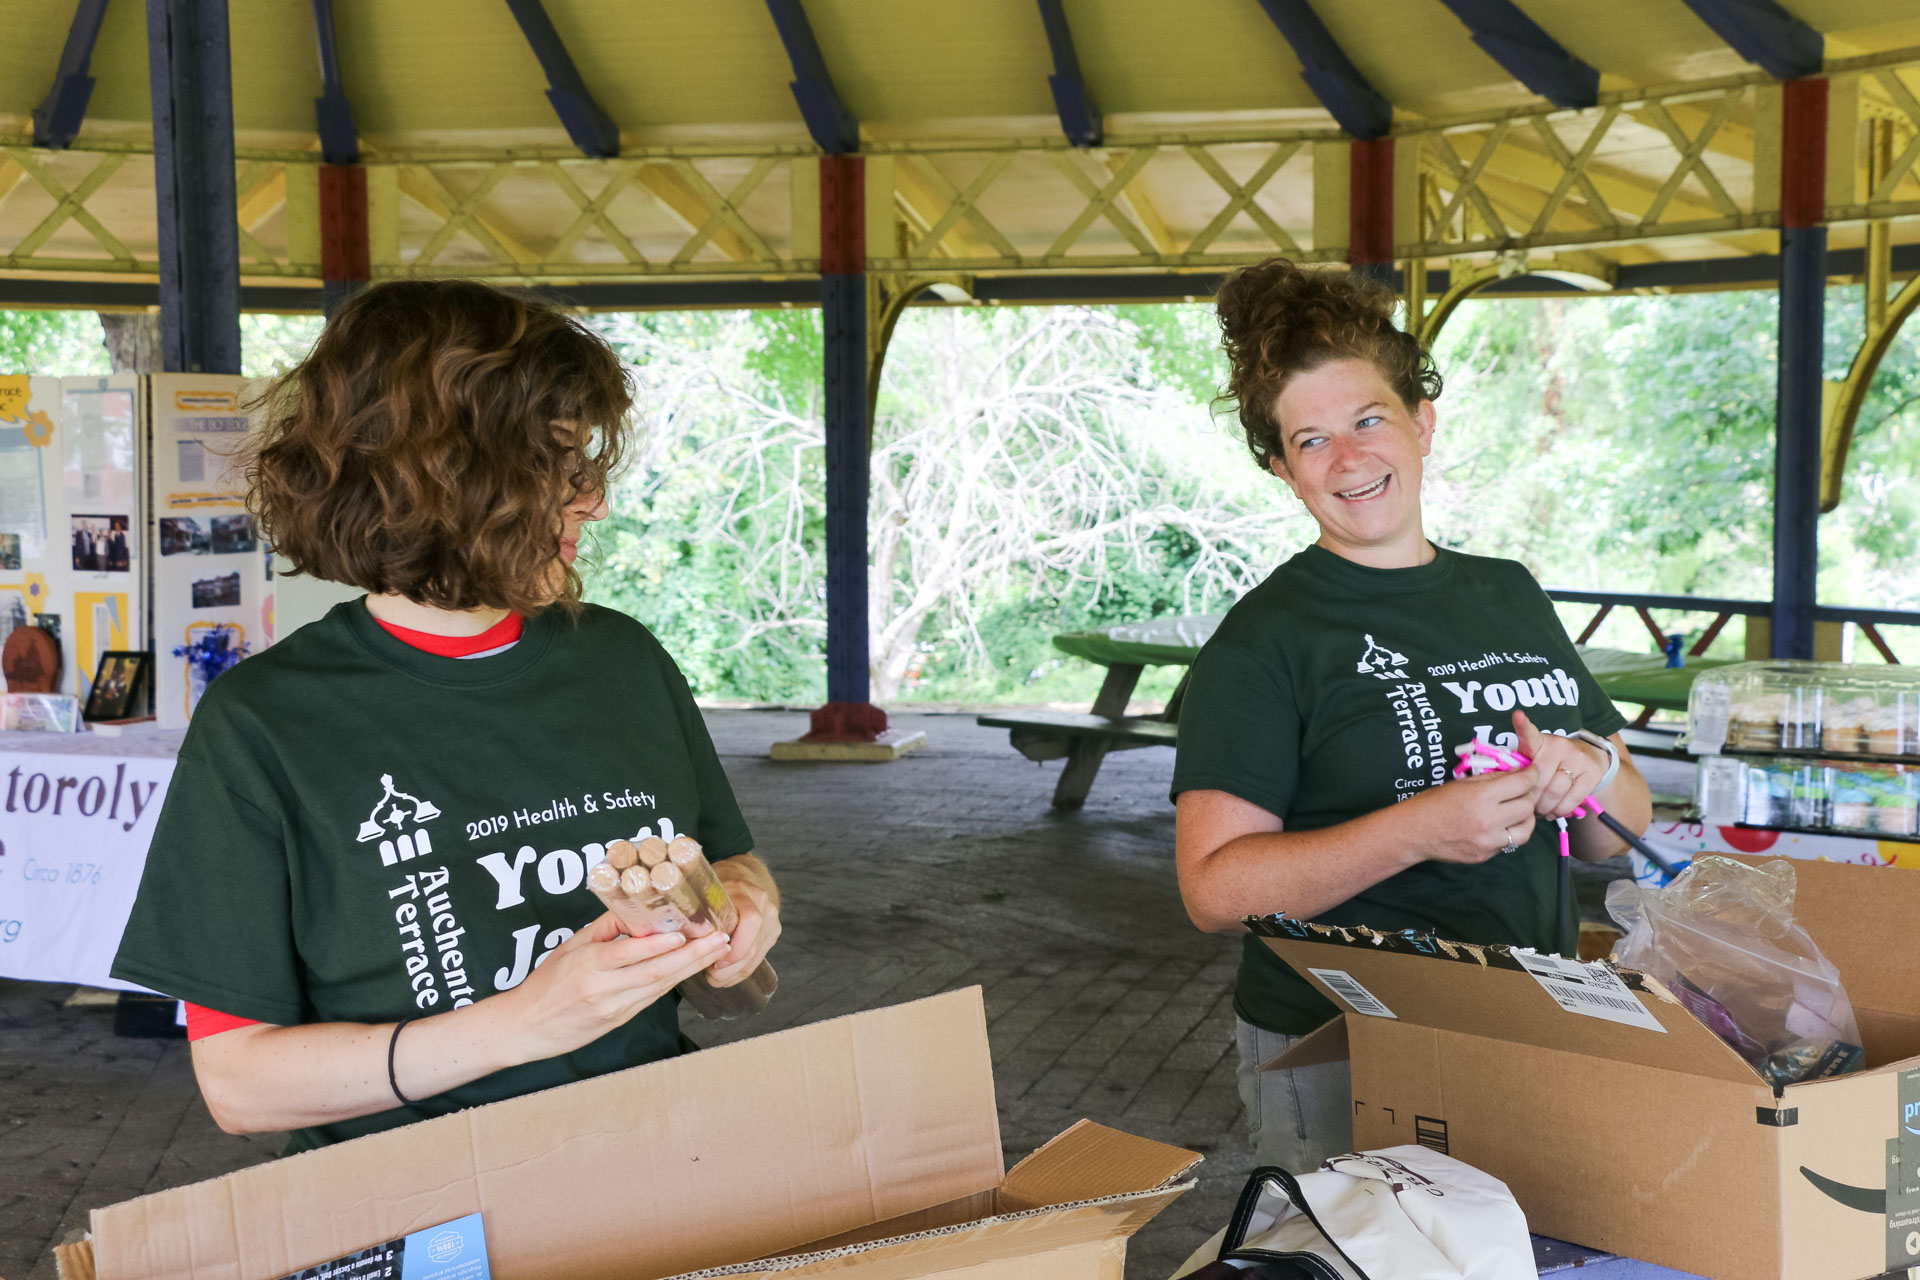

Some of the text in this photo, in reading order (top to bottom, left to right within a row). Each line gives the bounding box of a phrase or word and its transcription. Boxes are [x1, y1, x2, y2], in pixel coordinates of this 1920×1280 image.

[1427, 652, 1549, 677] 2019 Health & Safety
[1441, 669, 1579, 714] Youth
[1386, 685, 1424, 770] Terrace
[6, 763, 158, 832] toroly
[1395, 779, 1425, 789] Circa
[1397, 792, 1420, 803] 187
[467, 789, 656, 841] 2019 Health & Safety
[24, 858, 103, 885] Circa 1876
[388, 874, 439, 1009] Terrace
